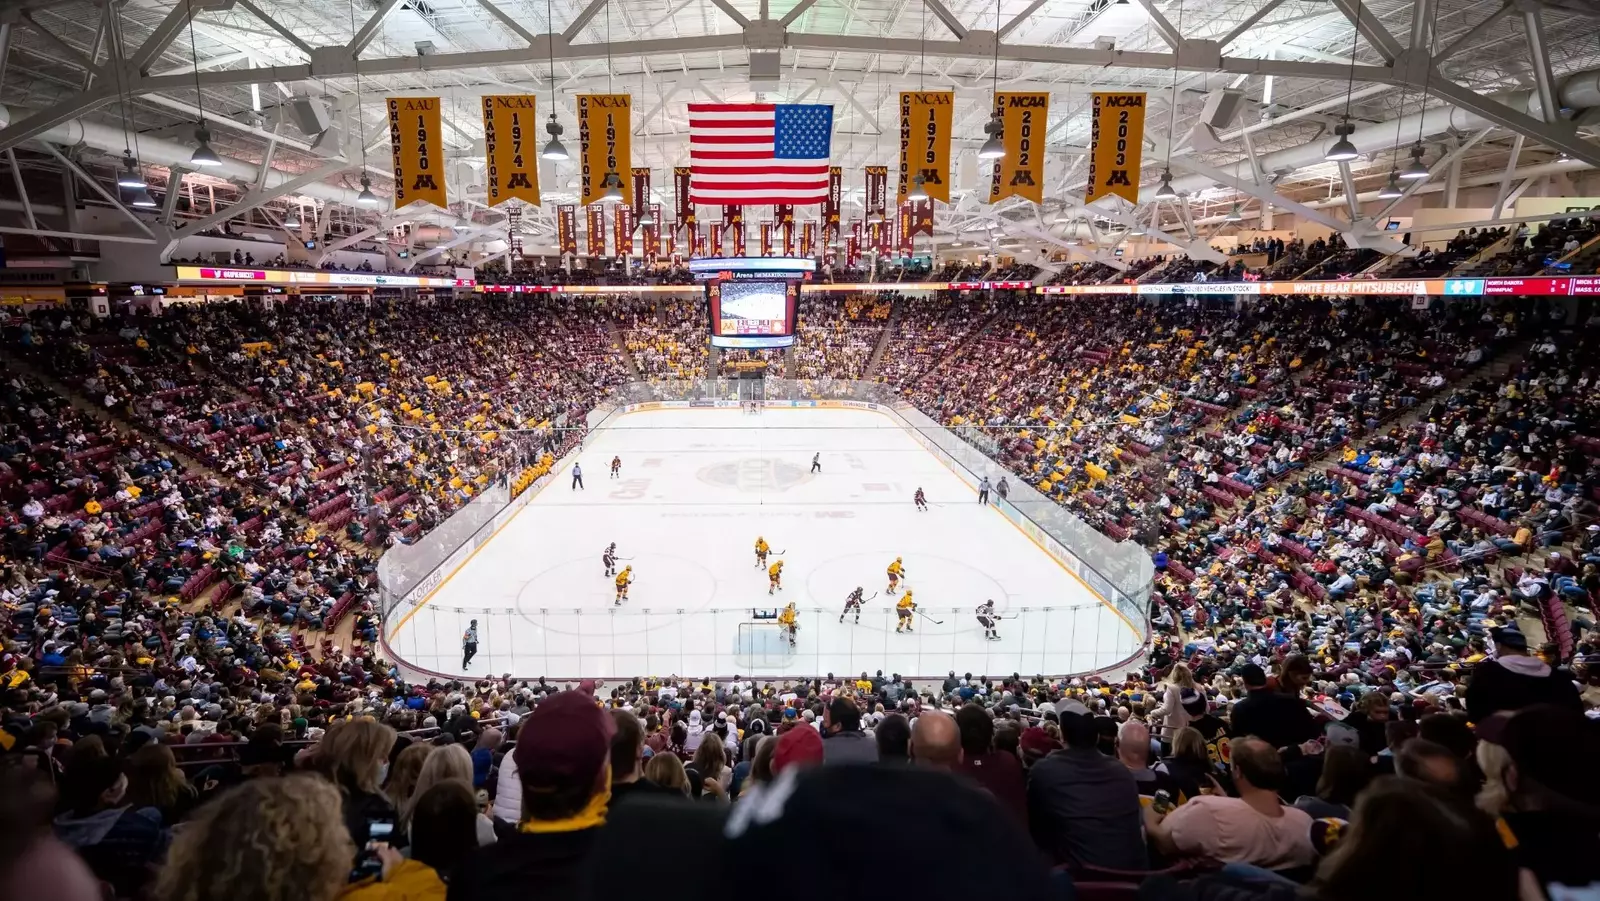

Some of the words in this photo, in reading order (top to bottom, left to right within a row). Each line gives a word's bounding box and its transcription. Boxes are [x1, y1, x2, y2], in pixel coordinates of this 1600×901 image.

[404, 100, 434, 111] AAU
[496, 96, 533, 108] NCAA
[592, 96, 628, 108] NCAA
[914, 94, 950, 104] NCAA
[1009, 96, 1046, 108] NCAA
[1105, 96, 1142, 108] NCAA
[390, 100, 404, 200] CHAMPIONS
[416, 115, 429, 170] 1940
[485, 98, 498, 198] CHAMPIONS
[512, 112, 524, 168] 1974
[580, 97, 591, 197] CHAMPIONS
[606, 113, 617, 168] 1976
[900, 94, 910, 195] CHAMPIONS
[926, 108, 936, 164] 1979
[1019, 110, 1032, 166] 2002
[1088, 96, 1100, 196] CHAMPIONS
[1116, 110, 1128, 166] 2003
[1294, 282, 1324, 292] WHITE
[1324, 282, 1350, 292] BEAR
